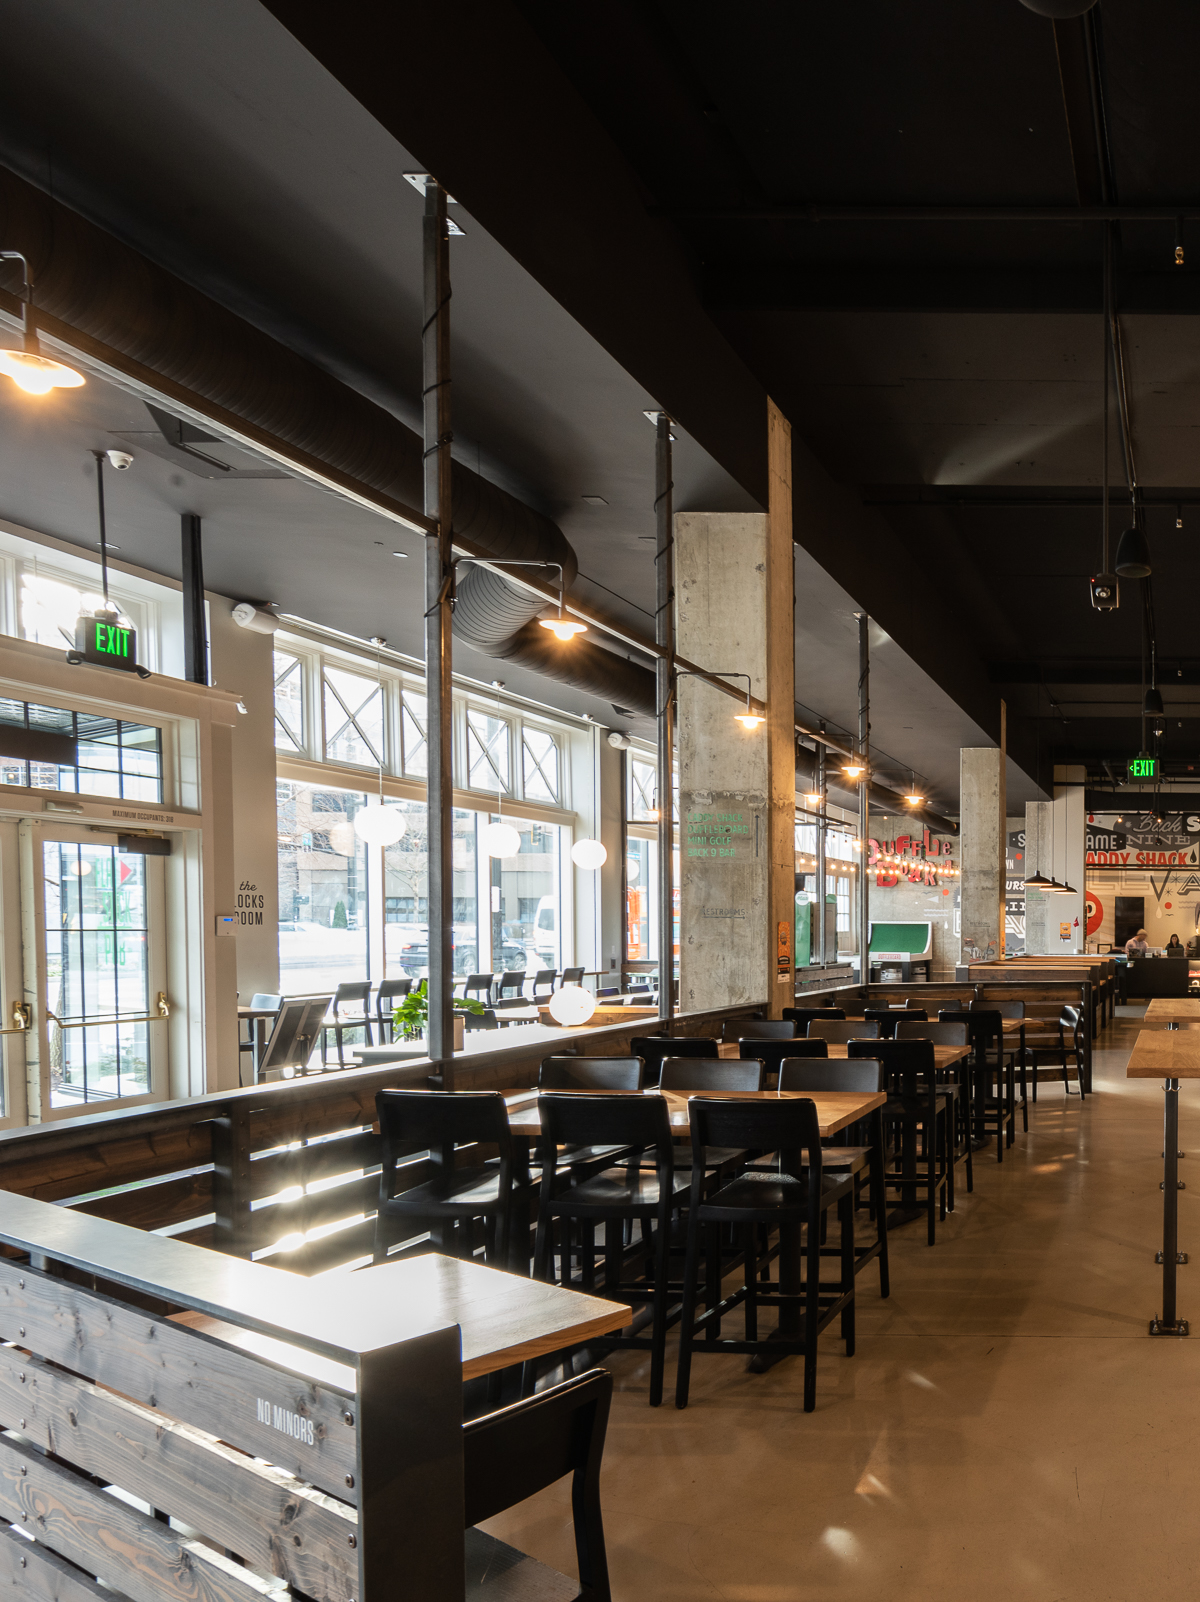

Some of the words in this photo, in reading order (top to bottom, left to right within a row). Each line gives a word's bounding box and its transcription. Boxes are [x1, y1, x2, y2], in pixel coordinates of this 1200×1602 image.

[95, 622, 130, 658] EXIT
[1133, 760, 1155, 776] EXIT
[112, 809, 137, 819] MAXIMUM
[687, 812, 714, 822] CADDY
[716, 813, 743, 822] SHACK
[687, 824, 749, 834] DUFFLEBOARD
[1132, 815, 1182, 832] Back
[687, 836, 707, 845] MINI
[709, 836, 732, 846] GOLF
[1086, 834, 1118, 850] AME
[1126, 835, 1190, 845] NINE
[687, 848, 709, 857] BACK
[710, 848, 717, 858] 9
[719, 848, 736, 858] BAR
[1086, 851, 1131, 868] ADDY
[1135, 851, 1188, 868] SHACK
[239, 880, 258, 892] the
[234, 893, 265, 909] OCKS
[257, 1397, 271, 1426] NO
[273, 1404, 314, 1446] MINORS
